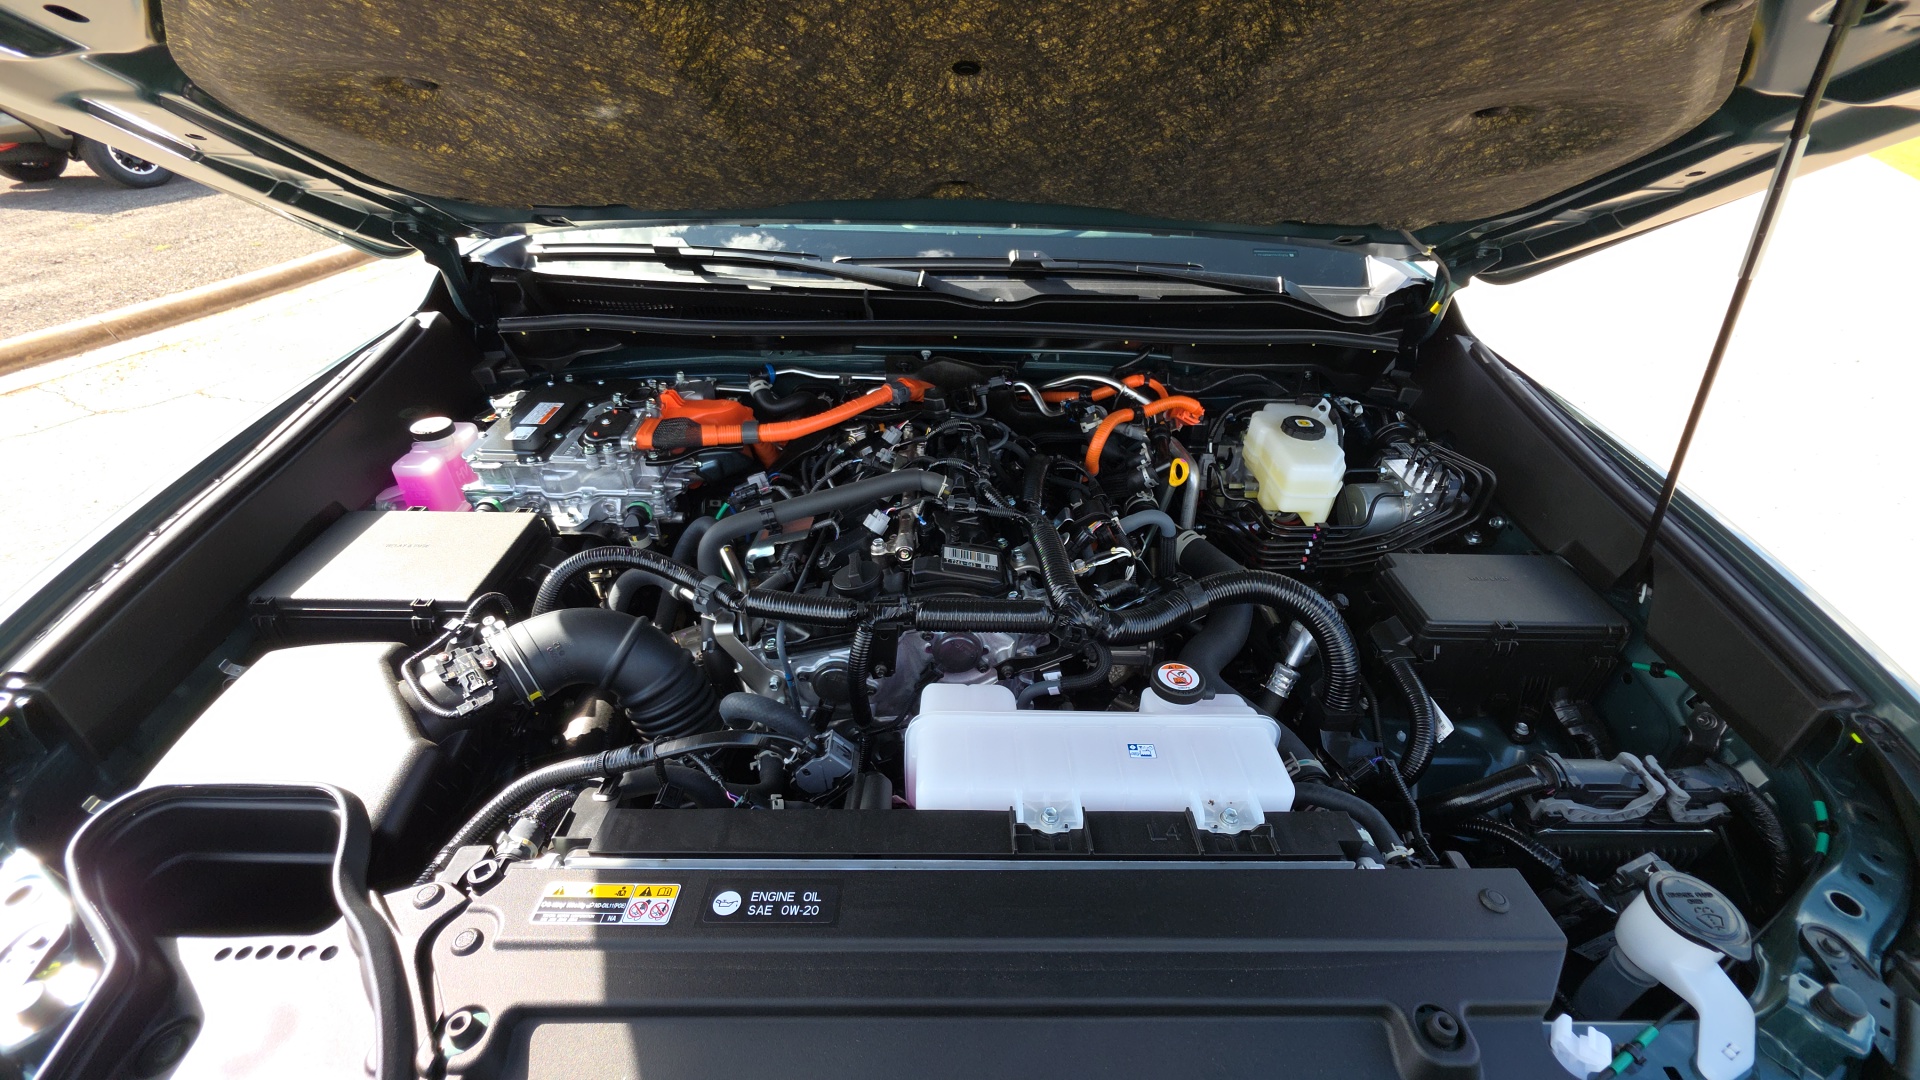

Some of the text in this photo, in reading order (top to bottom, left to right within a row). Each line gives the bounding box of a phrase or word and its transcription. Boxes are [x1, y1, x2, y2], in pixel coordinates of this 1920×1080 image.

[751, 891, 822, 902] ENGINE OIL
[747, 905, 820, 916] SAE 0W-20
[607, 914, 617, 922] NA
